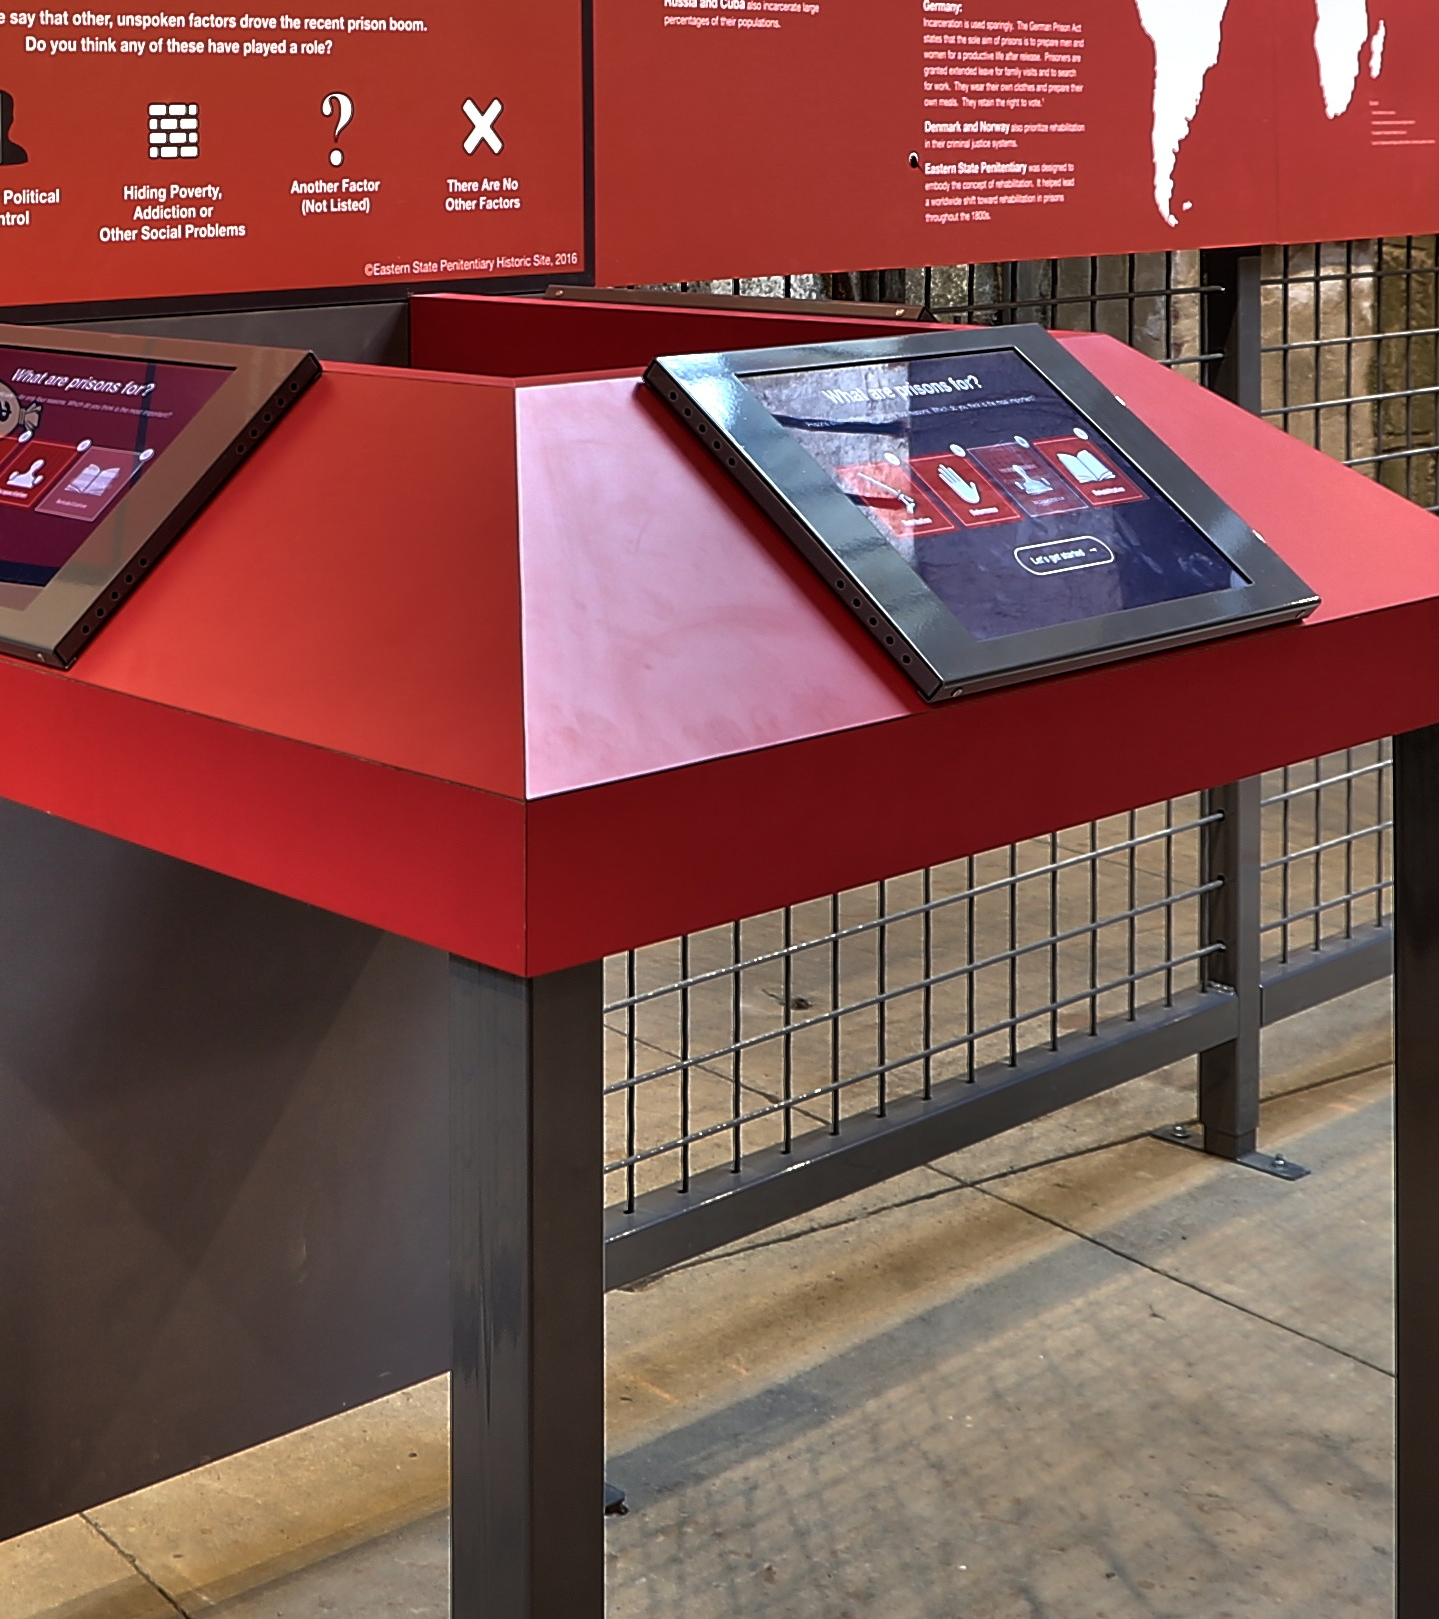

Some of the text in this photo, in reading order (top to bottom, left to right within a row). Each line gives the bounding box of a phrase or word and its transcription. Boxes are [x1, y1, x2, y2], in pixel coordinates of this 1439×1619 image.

[124, 185, 222, 202] Hiding Poverty,
[291, 179, 380, 193] Another Factor
[447, 178, 518, 192] There Are No
[4, 189, 59, 204] Political
[446, 197, 520, 211] Other Factors
[133, 205, 213, 220] Addiction or
[302, 198, 370, 215] (Not Listed)
[100, 223, 245, 241] Other Social Problems
[364, 253, 577, 276] ©Eastern State Penitentiary Historic Site, 2016
[12, 368, 156, 397] What are prisons for?
[822, 375, 983, 404] What are prisons for?
